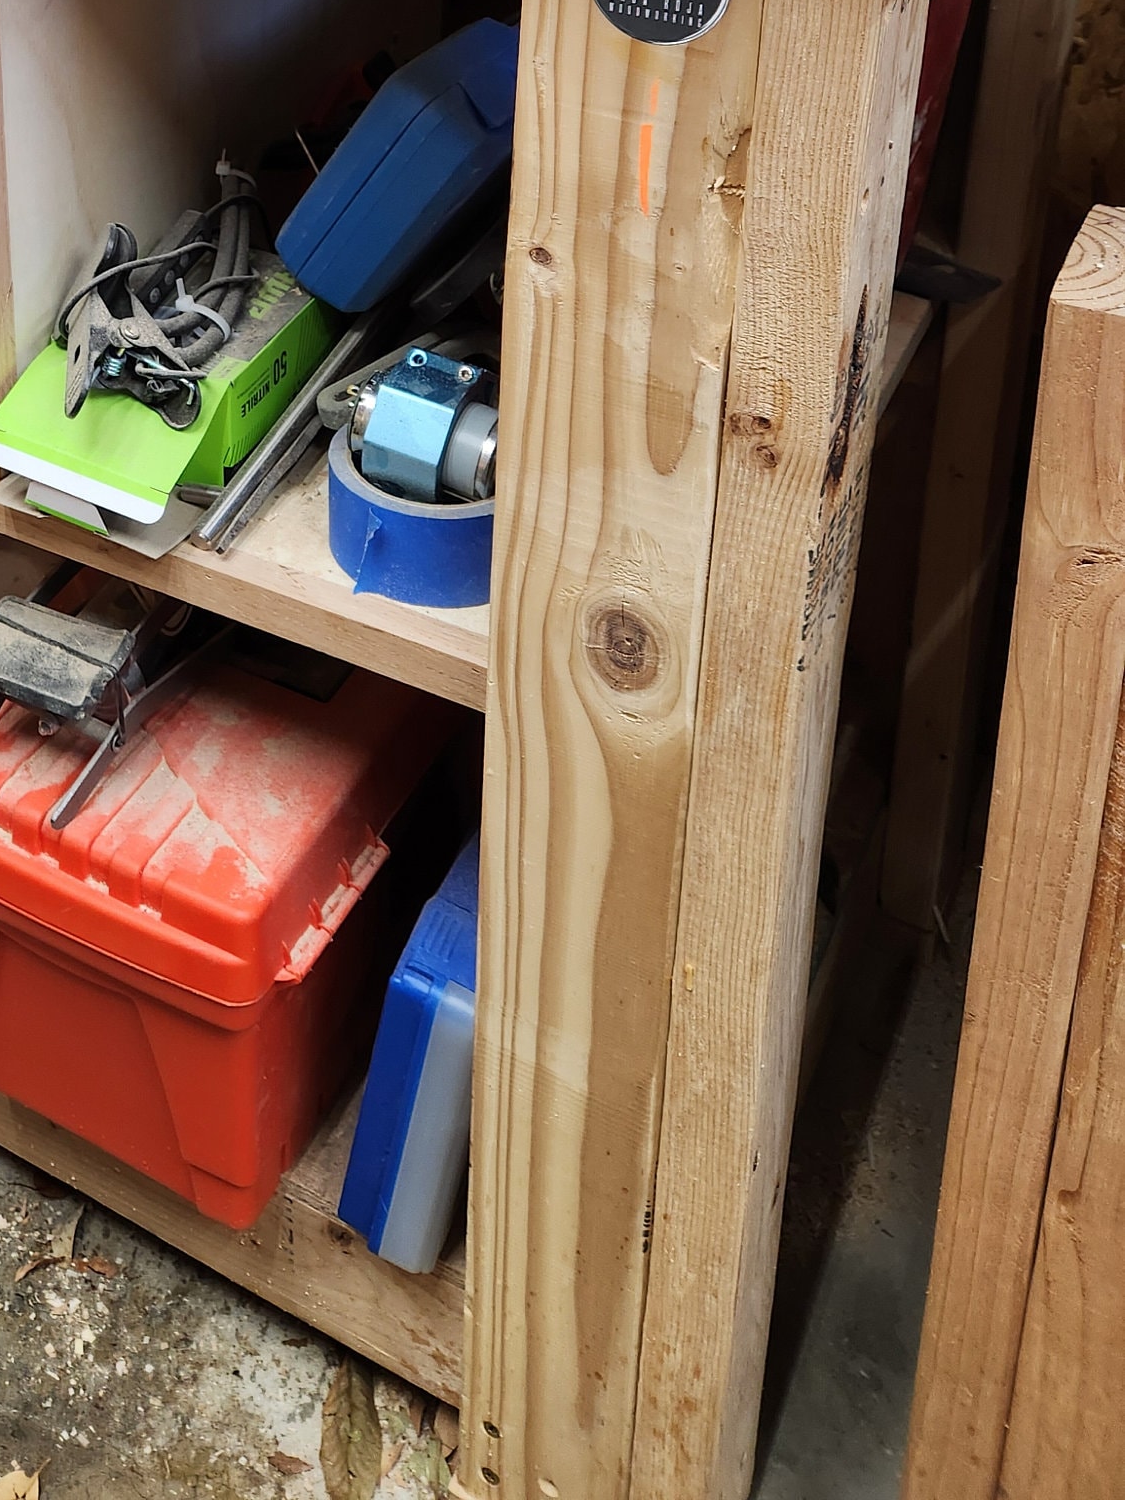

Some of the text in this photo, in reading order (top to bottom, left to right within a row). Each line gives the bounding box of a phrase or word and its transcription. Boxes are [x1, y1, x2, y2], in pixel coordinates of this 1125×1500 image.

[609, 2, 703, 28] WOODWORKING
[241, 350, 287, 417] 50 NITRILE
